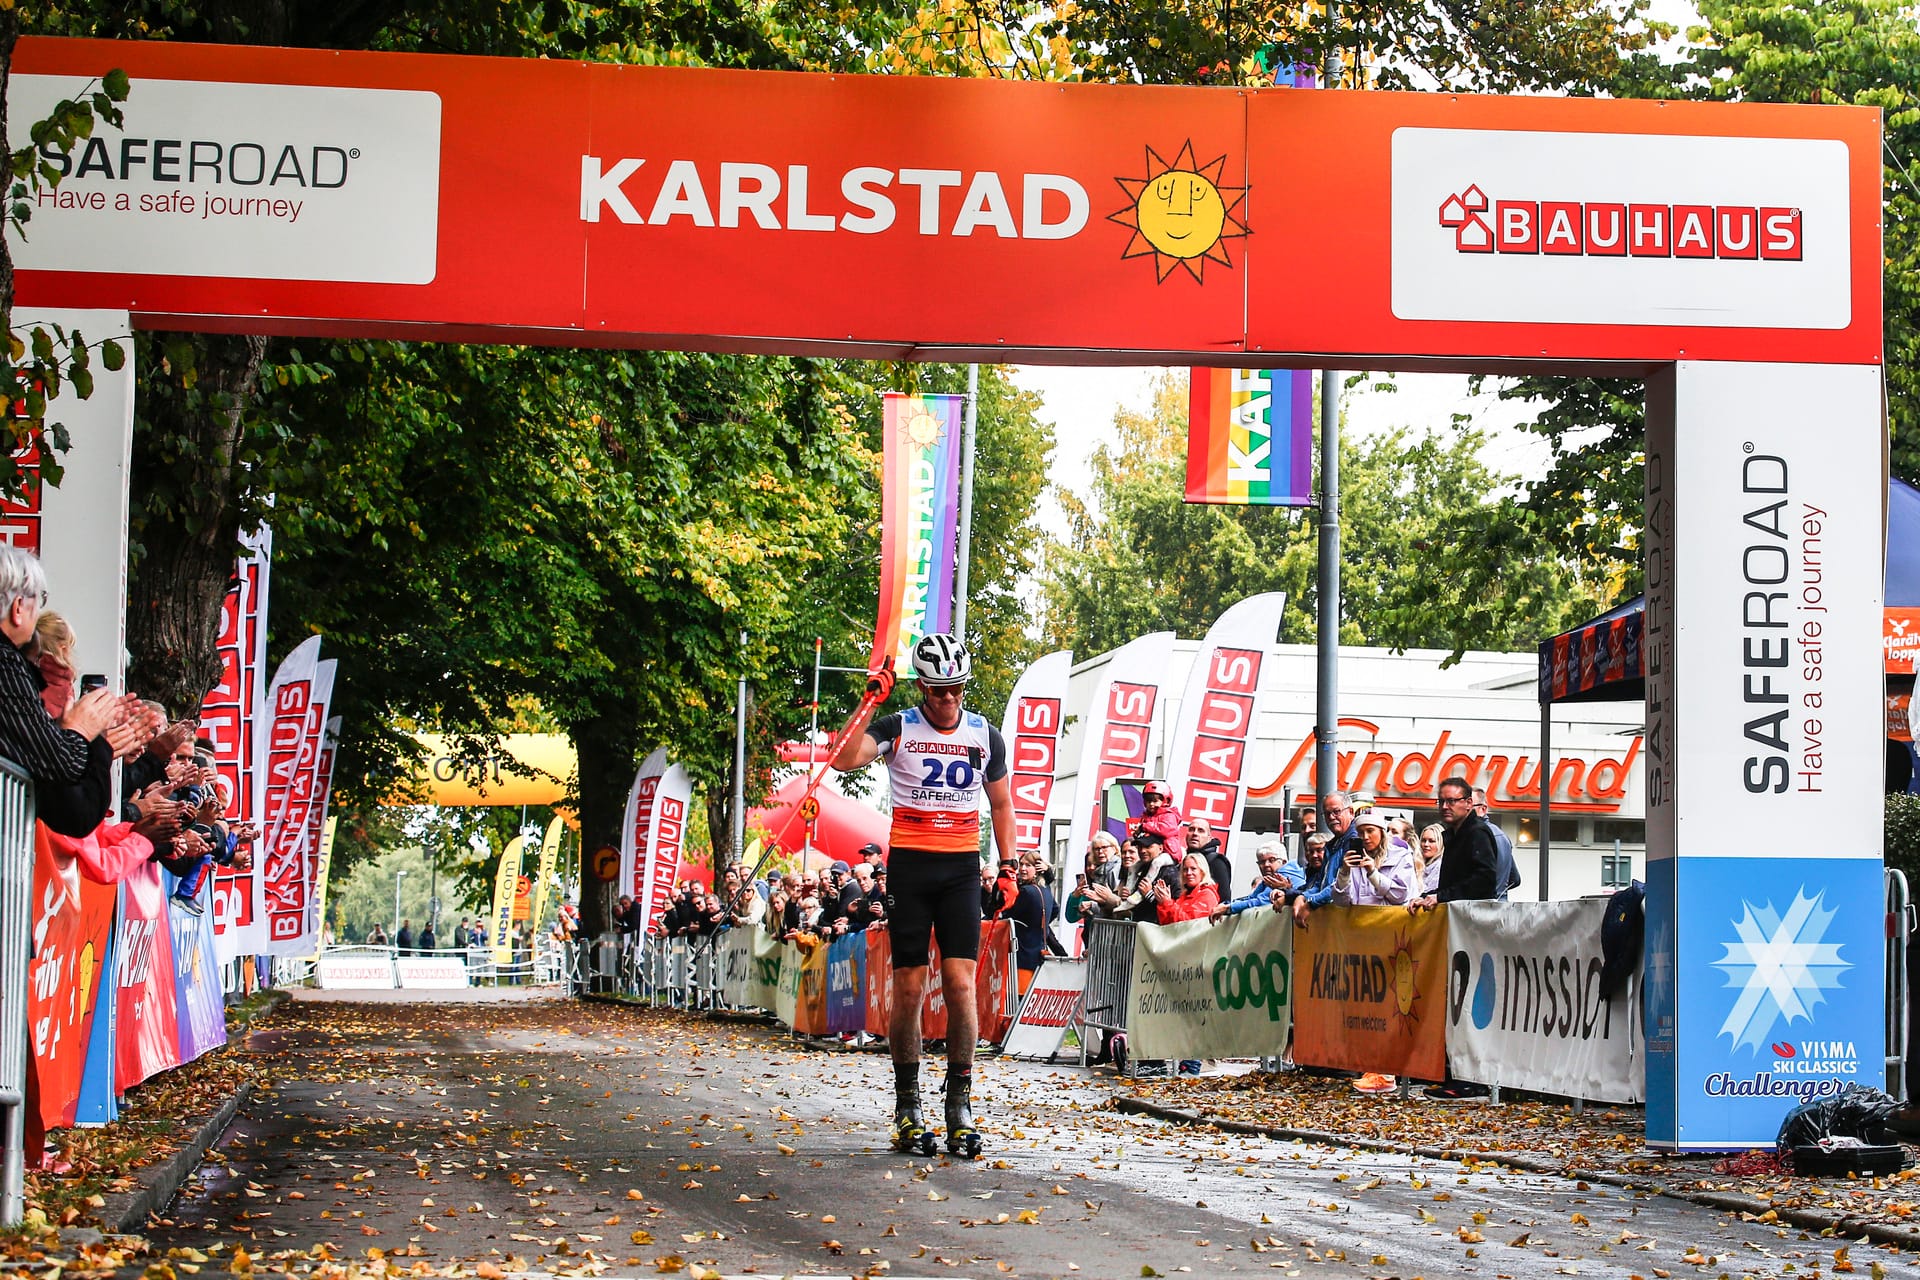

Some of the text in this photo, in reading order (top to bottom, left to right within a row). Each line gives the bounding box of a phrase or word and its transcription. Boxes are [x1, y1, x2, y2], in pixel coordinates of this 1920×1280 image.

[38, 184, 304, 223] Have a safe journey
[580, 154, 1091, 240] KARLSTAD
[1797, 503, 1828, 793] Have a safe journey
[911, 790, 974, 802] SAFEROAD
[921, 758, 974, 790] 20
[648, 799, 683, 926] AUHAUS
[1212, 950, 1290, 1022] coop
[1309, 953, 1387, 1003] KARLSTAD
[1772, 1060, 1857, 1074] SKI CLASSICS
[1801, 1041, 1857, 1059] VISMA
